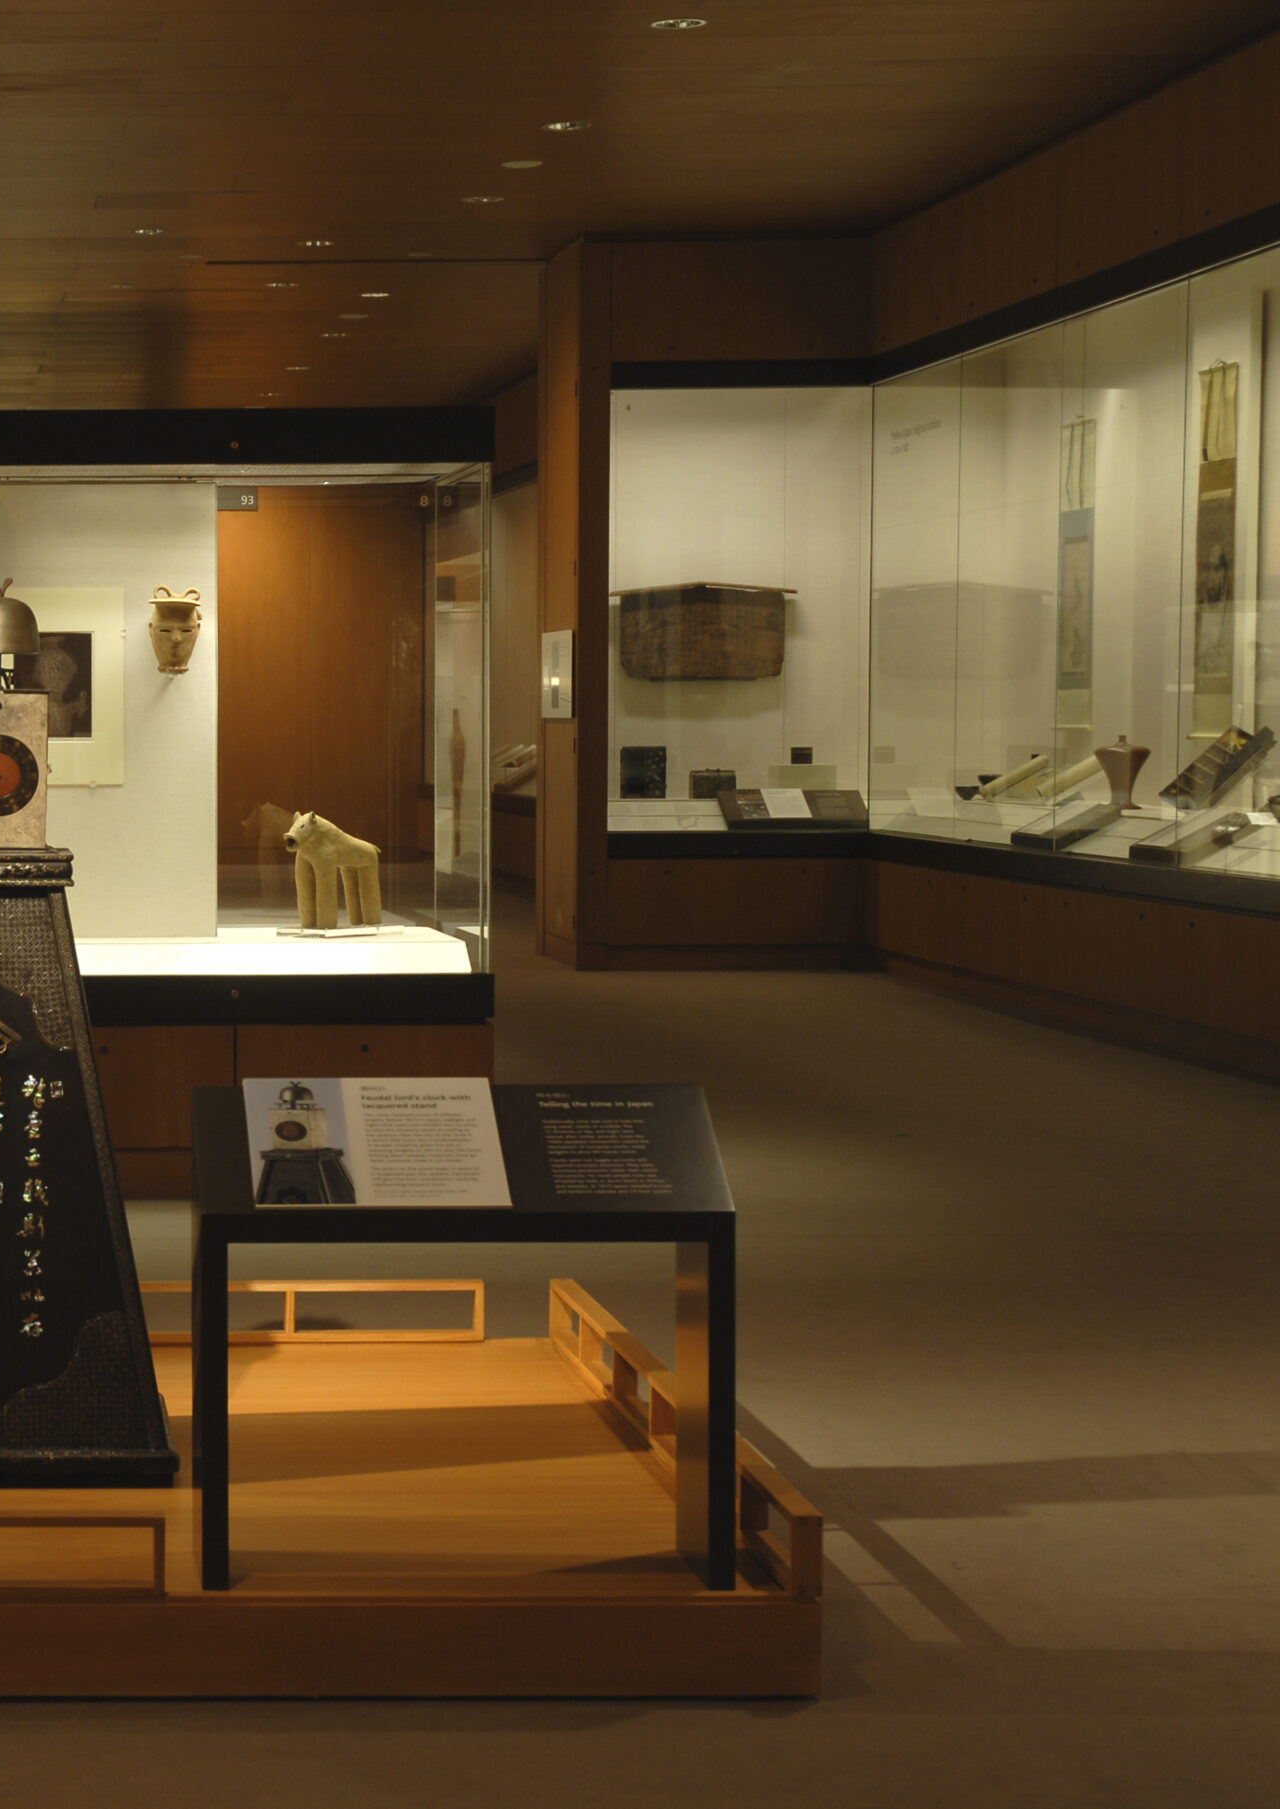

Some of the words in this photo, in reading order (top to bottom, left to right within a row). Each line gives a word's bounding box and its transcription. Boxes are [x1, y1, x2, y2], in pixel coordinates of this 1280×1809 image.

[241, 495, 254, 505] 93
[361, 1093, 391, 1101] Feudal
[422, 1093, 447, 1101] clock
[449, 1093, 472, 1101] with
[538, 1100, 570, 1109] Telling
[627, 1101, 654, 1109] Japan
